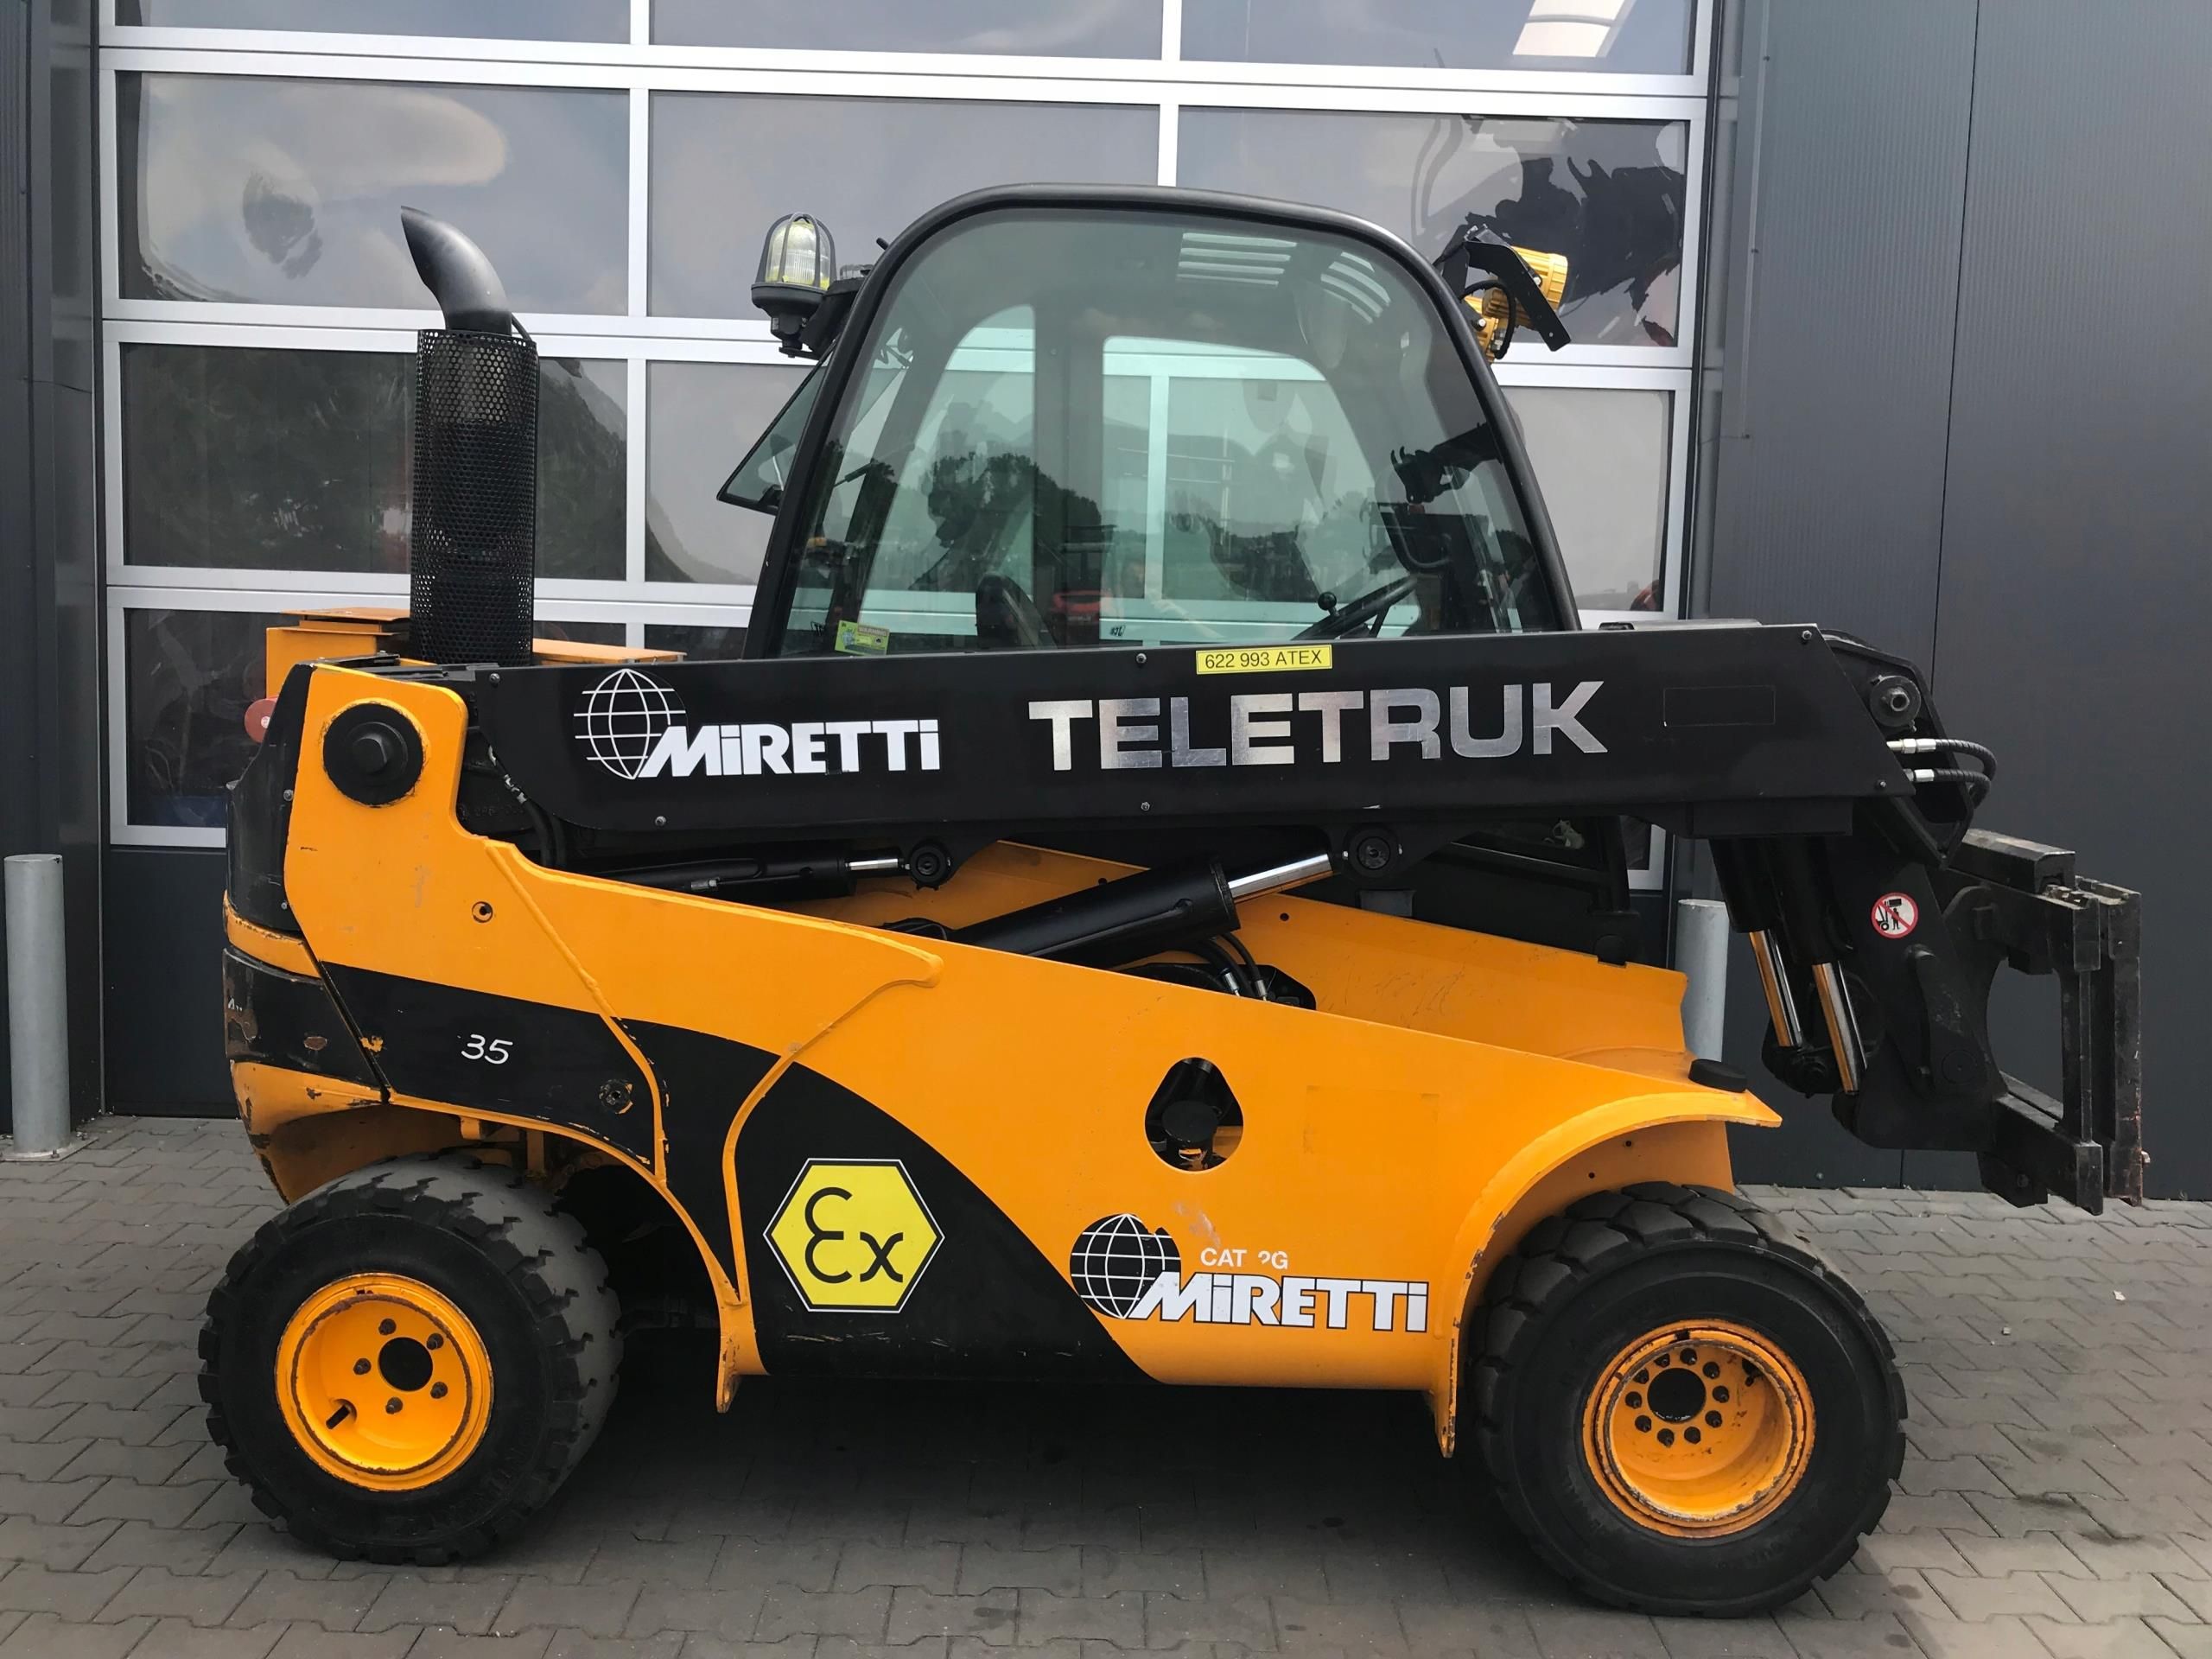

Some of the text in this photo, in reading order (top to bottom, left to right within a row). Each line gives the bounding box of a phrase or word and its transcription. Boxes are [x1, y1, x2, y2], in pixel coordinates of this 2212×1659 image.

[1205, 649, 1323, 669] 622 993 ATEX
[1028, 681, 1608, 771] TELETRUK
[461, 1033, 514, 1065] 35
[804, 1186, 904, 1284] Ex
[1200, 1248, 1248, 1268] CAT
